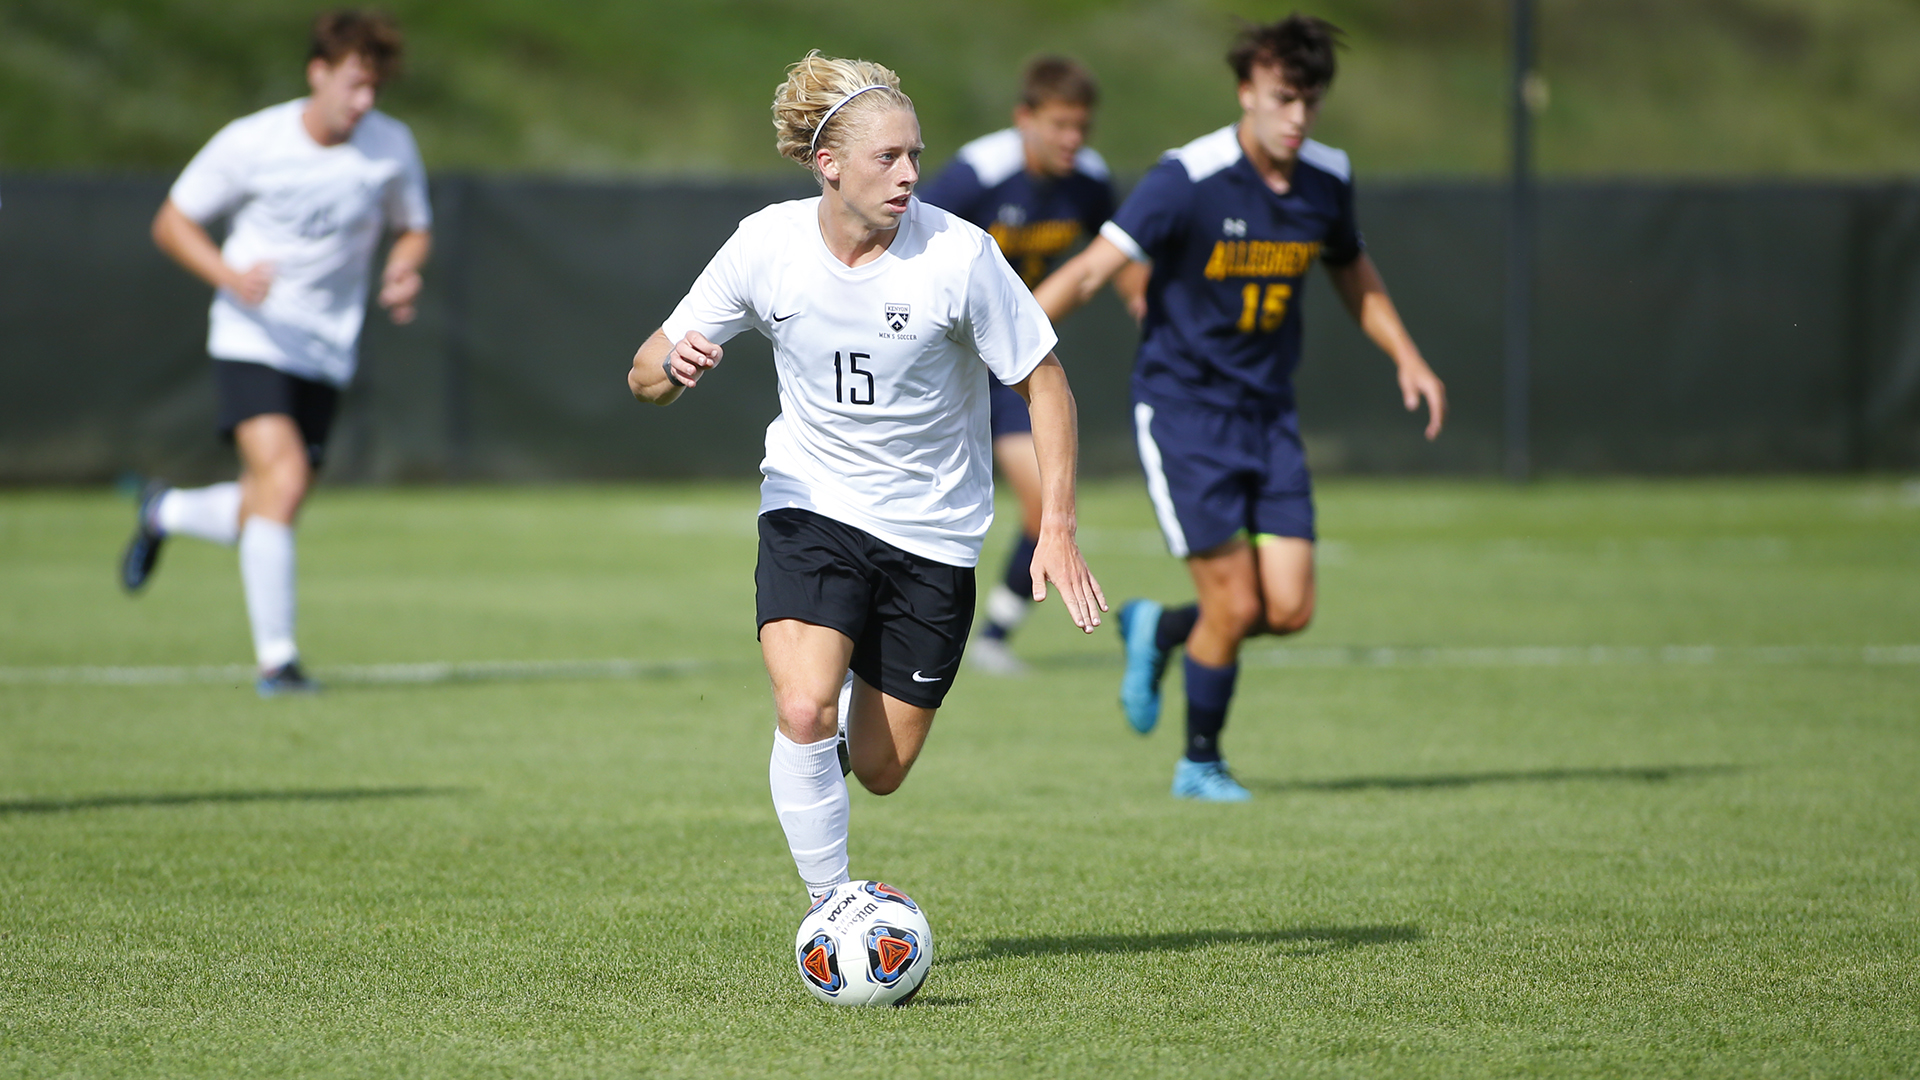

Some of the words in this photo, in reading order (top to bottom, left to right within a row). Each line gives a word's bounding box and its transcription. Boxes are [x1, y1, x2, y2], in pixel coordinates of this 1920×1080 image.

[1238, 282, 1292, 332] 15
[833, 351, 874, 405] 15
[827, 893, 857, 922] NCAA
[841, 902, 879, 935] Wilson
